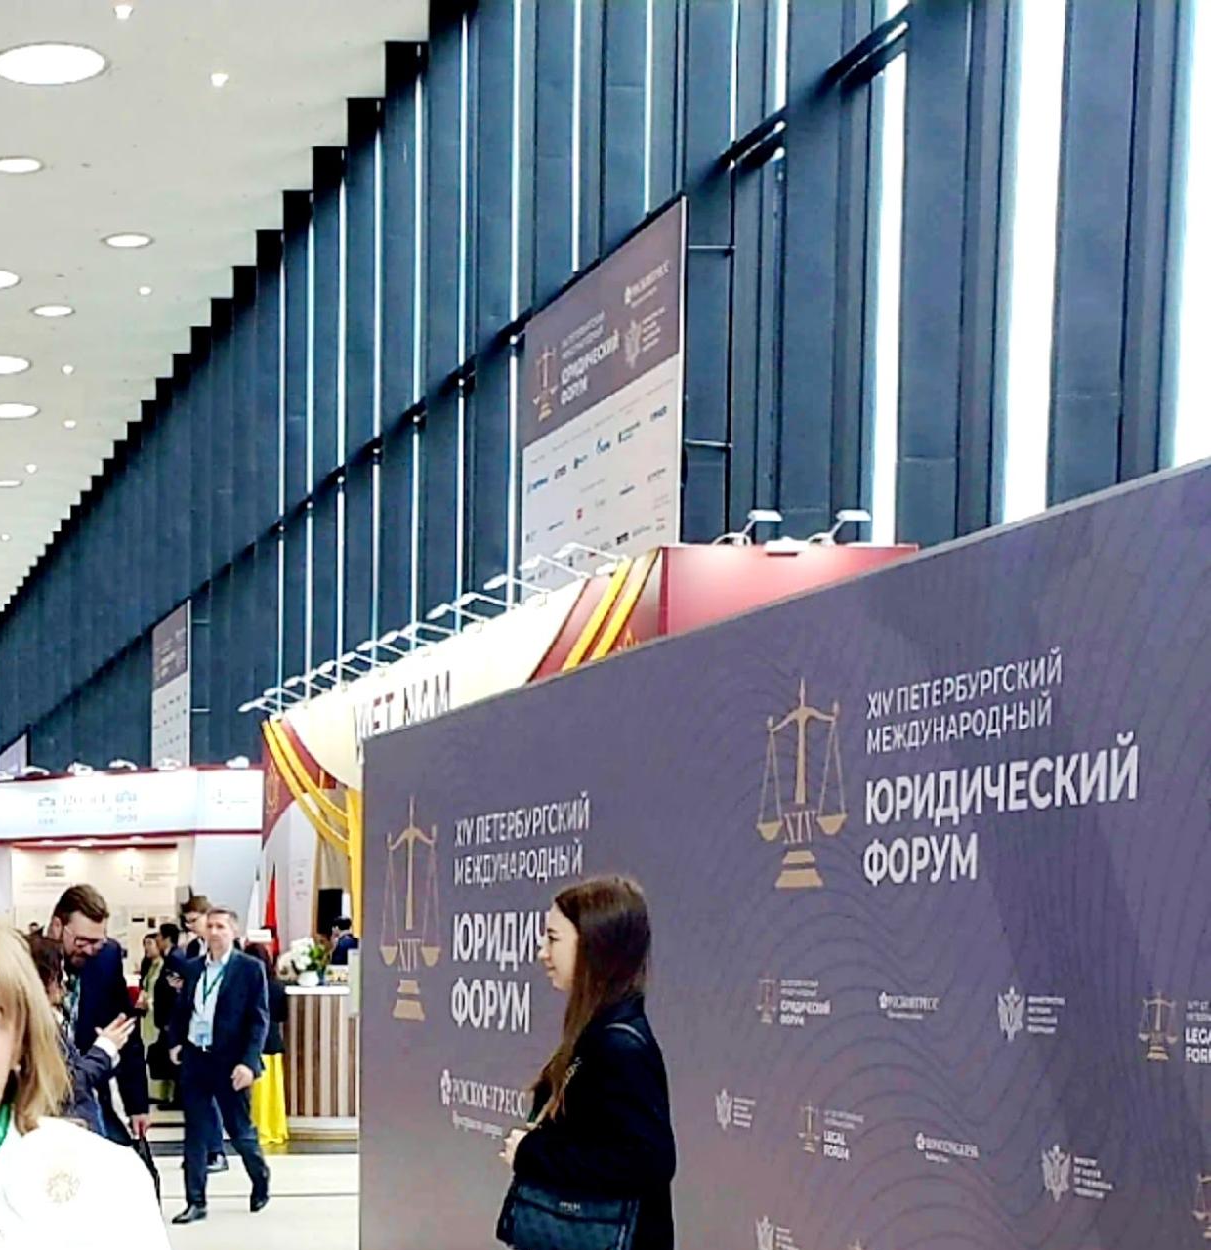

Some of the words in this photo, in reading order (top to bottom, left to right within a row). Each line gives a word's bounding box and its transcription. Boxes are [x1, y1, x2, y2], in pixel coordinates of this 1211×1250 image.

[866, 688, 895, 721] XIV
[896, 646, 1063, 714] ПЕТЕРБУРГСКИЙ
[866, 689, 1053, 755] МЕЖДУНАРОДНЫЙ
[865, 730, 1139, 827] ЮРИДИЧЕСКИЙ
[475, 790, 590, 846] ПЕТЕРБУРГСКИЙ
[454, 837, 583, 889] МЕЖДУНАРОДНЫЙ
[863, 832, 979, 887] ФОРУМ
[450, 976, 531, 1034] ФОРУМ
[1185, 1046, 1211, 1064] FOR
